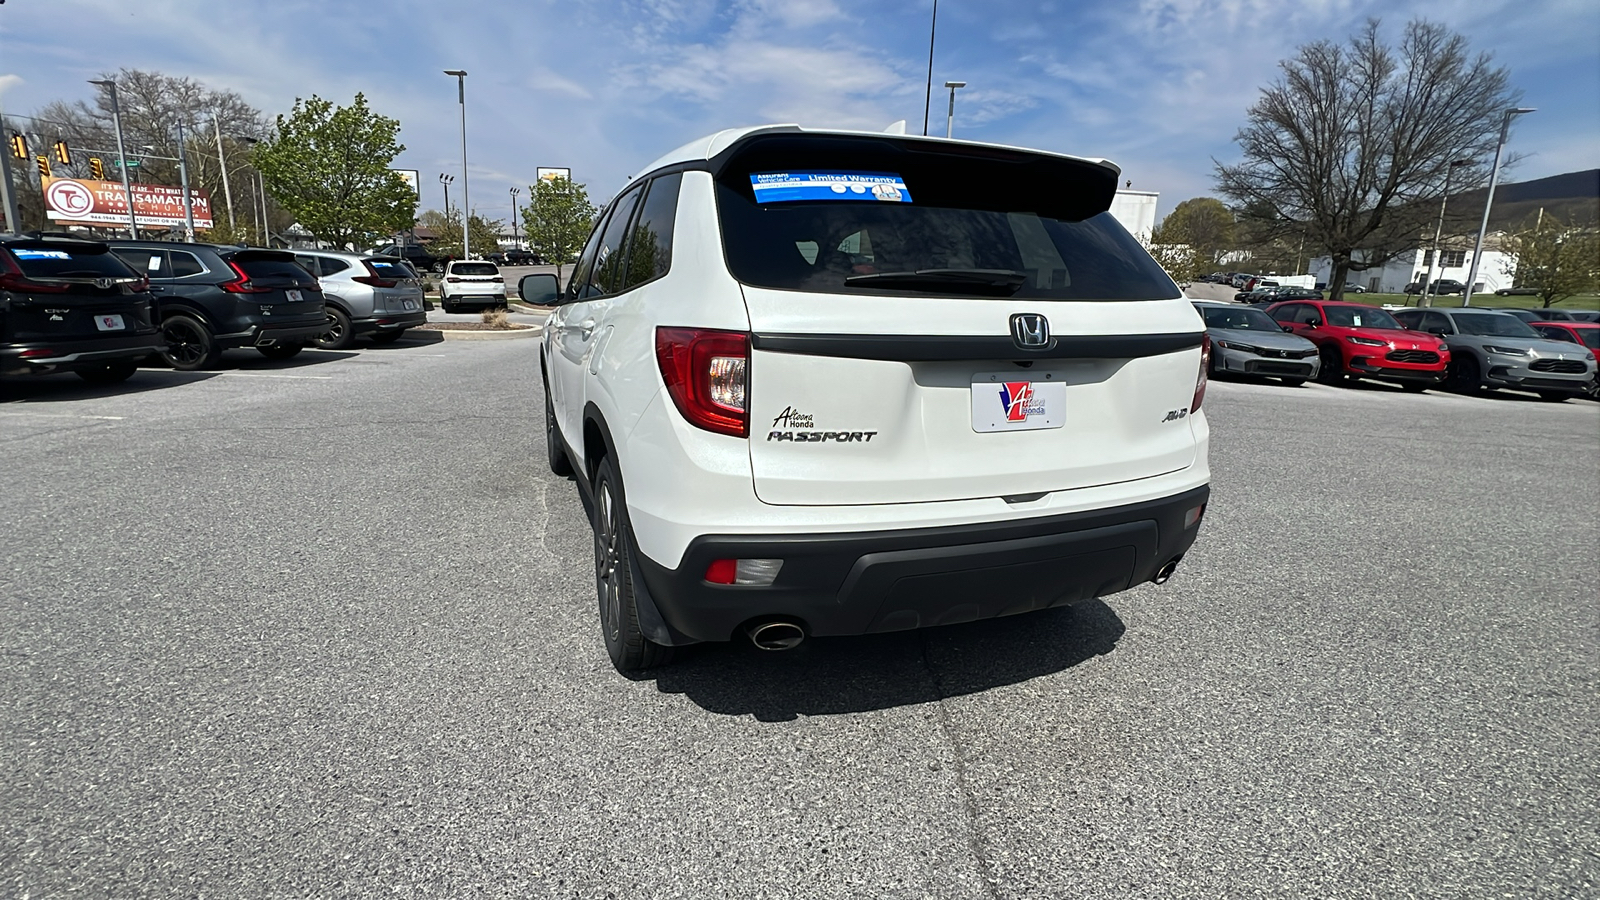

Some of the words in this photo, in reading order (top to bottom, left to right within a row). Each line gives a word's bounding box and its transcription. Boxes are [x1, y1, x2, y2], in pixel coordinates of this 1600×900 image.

[808, 174, 847, 182] Limited
[848, 175, 896, 184] Warranty
[95, 190, 207, 207] TRANS4MATION
[1022, 406, 1046, 415] Honda
[773, 405, 814, 428] Altoona
[766, 431, 878, 442] PASSPORT
